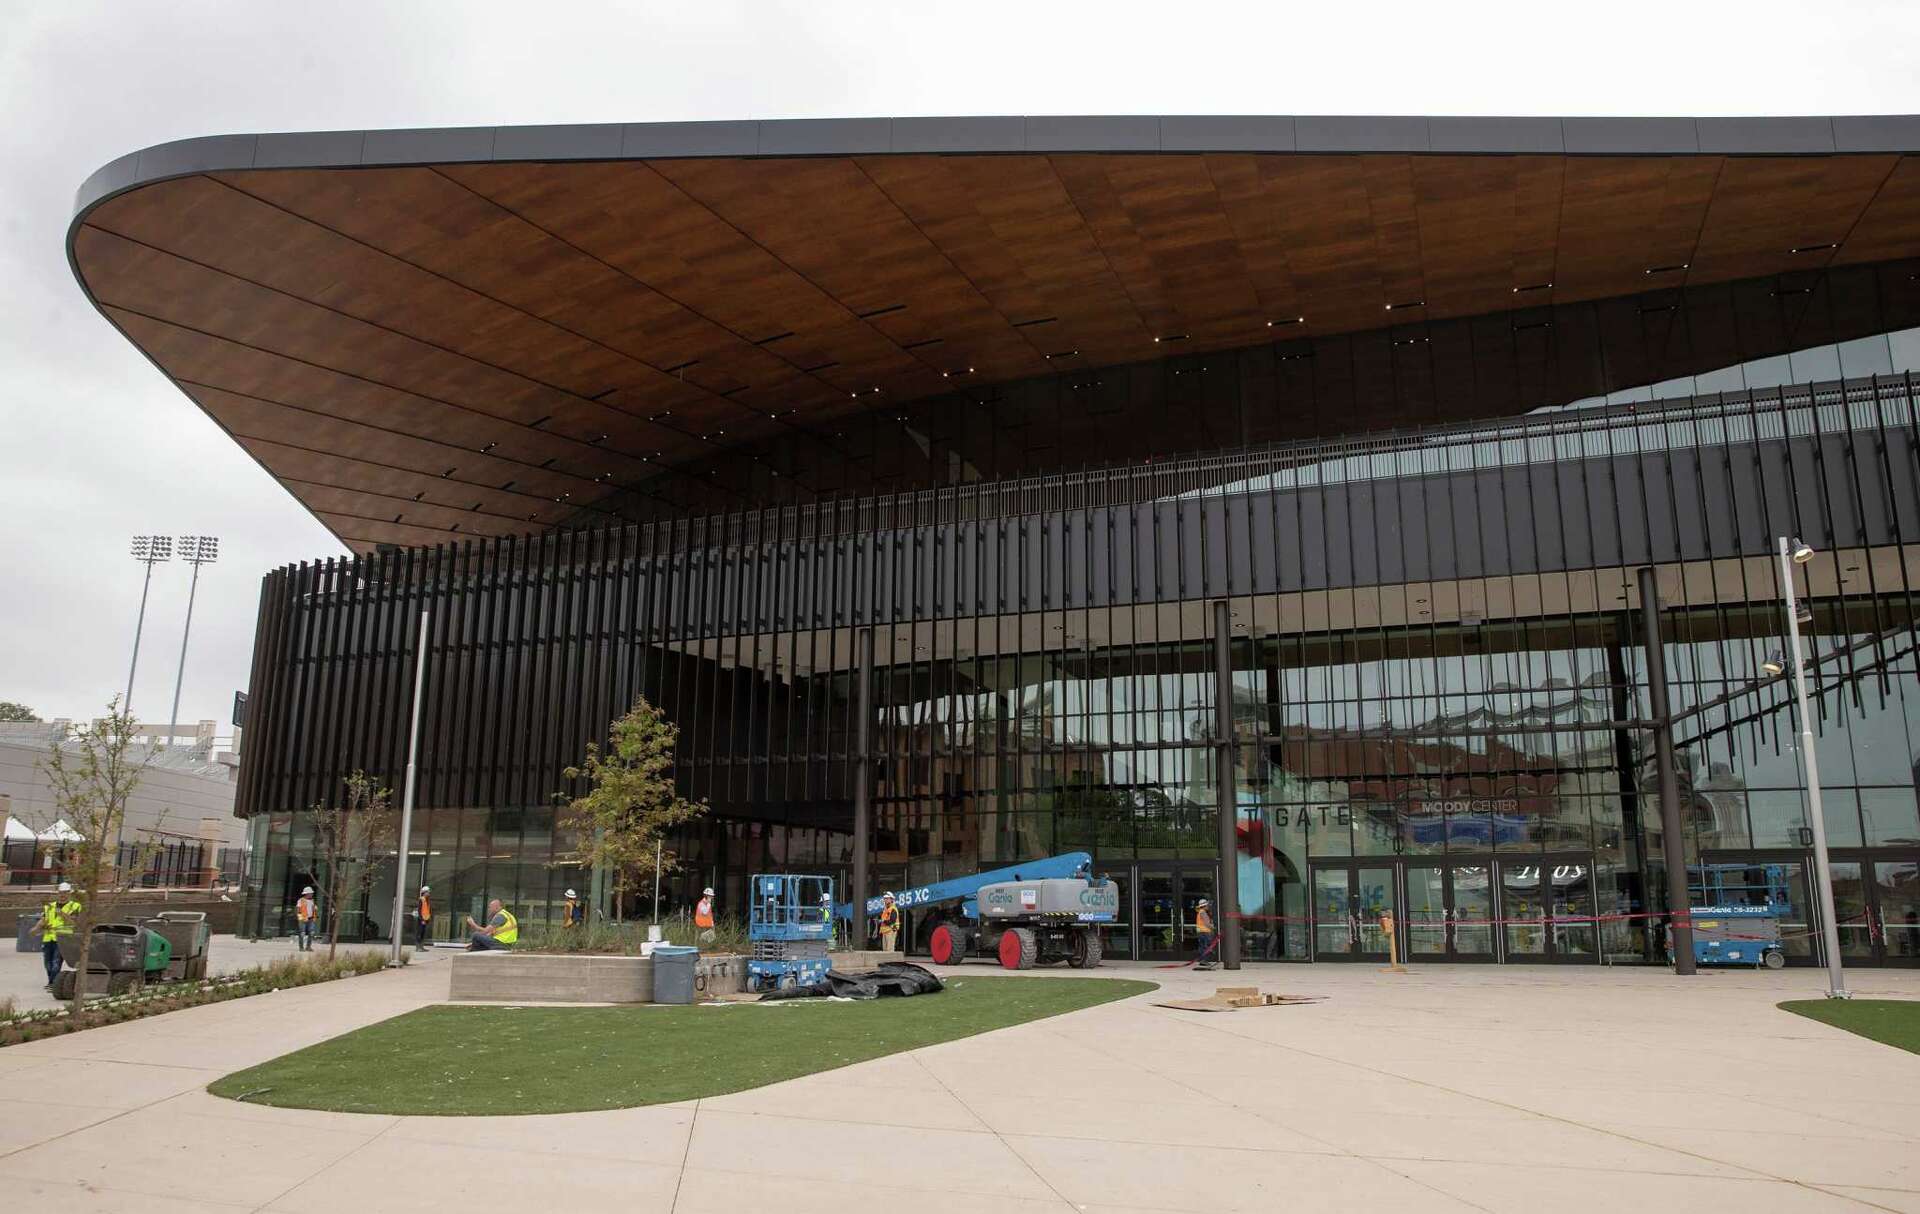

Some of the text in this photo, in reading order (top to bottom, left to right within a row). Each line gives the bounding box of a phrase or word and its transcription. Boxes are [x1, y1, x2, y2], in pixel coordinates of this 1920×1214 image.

[1422, 801, 1472, 813] MOODY
[1276, 806, 1350, 827] GATE
[915, 888, 930, 903] XC
